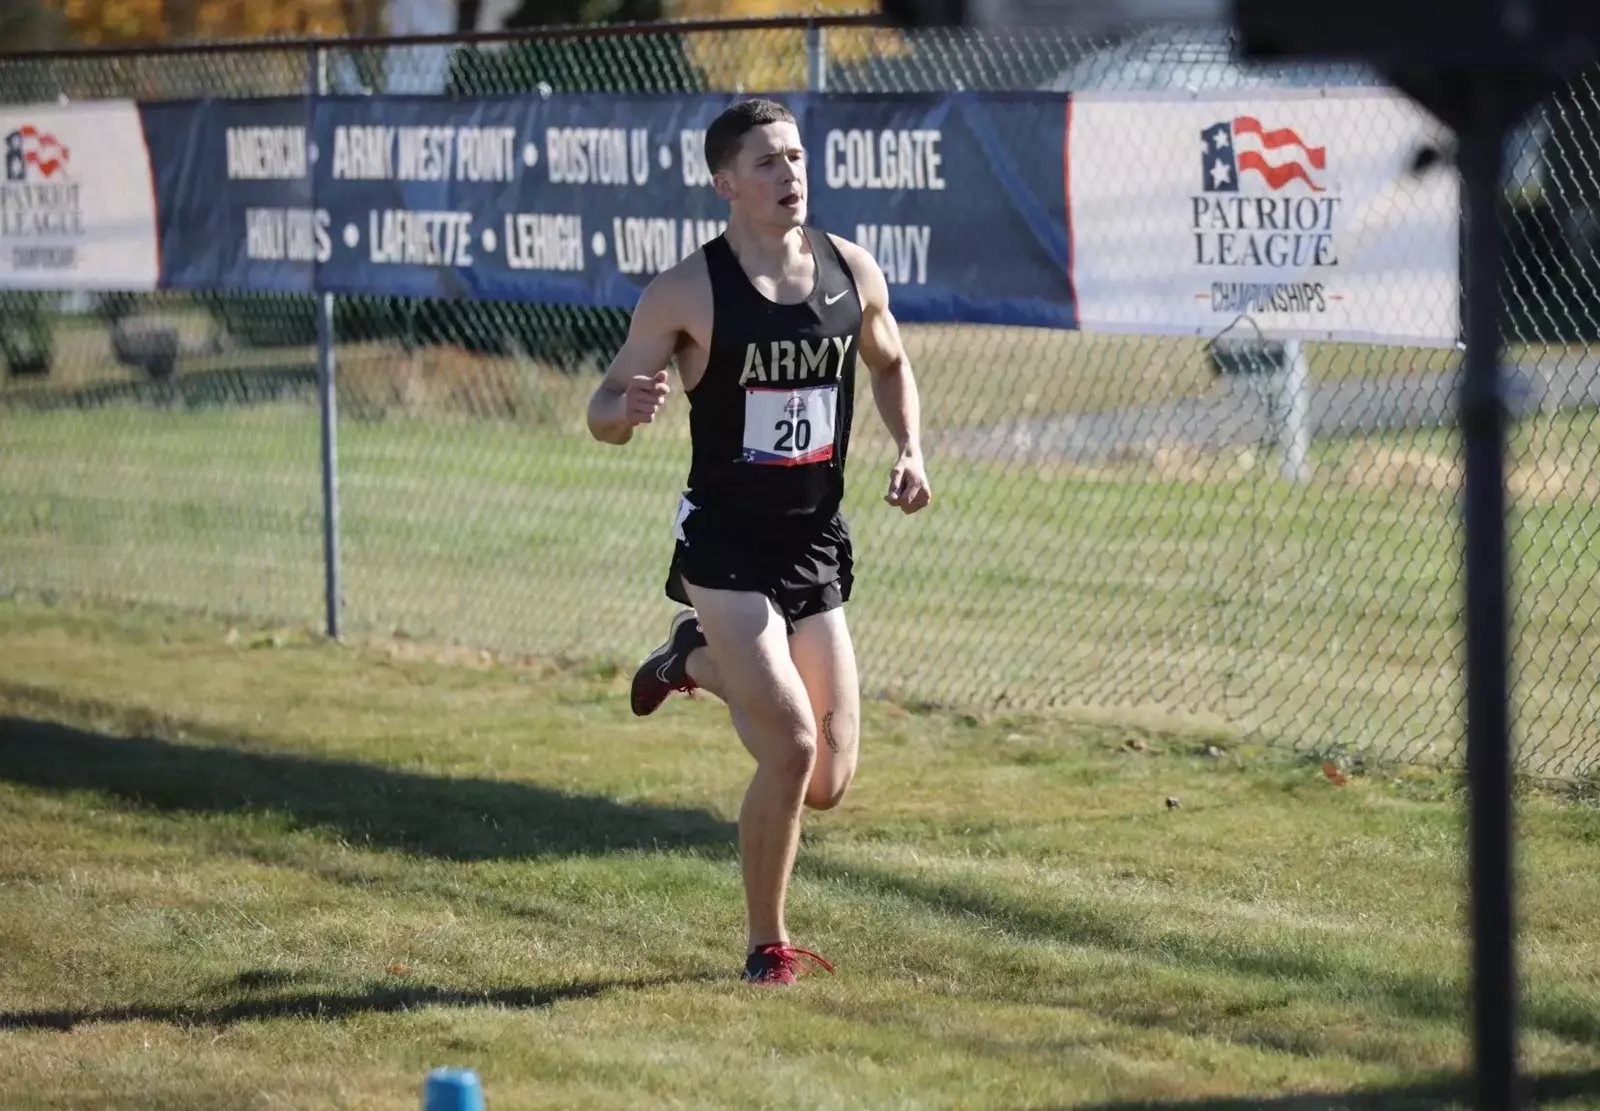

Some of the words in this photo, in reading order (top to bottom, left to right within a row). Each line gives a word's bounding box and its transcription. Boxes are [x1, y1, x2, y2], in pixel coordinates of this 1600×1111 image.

[332, 125, 396, 180] ARMY
[398, 125, 455, 182] WEST
[456, 126, 516, 182] POINT
[546, 127, 629, 185] BOSTON
[631, 128, 649, 186] U
[825, 128, 946, 190] COLGATE
[1190, 196, 1342, 231] PATRIOT
[505, 213, 584, 271] LEHIGH
[613, 216, 696, 274] LOYOLA
[856, 224, 931, 285] NAVY
[1193, 233, 1338, 268] LEAGUE
[1210, 281, 1326, 313] CHAMPIONSHIPS
[738, 335, 853, 386] ARMY
[773, 418, 811, 452] 20
